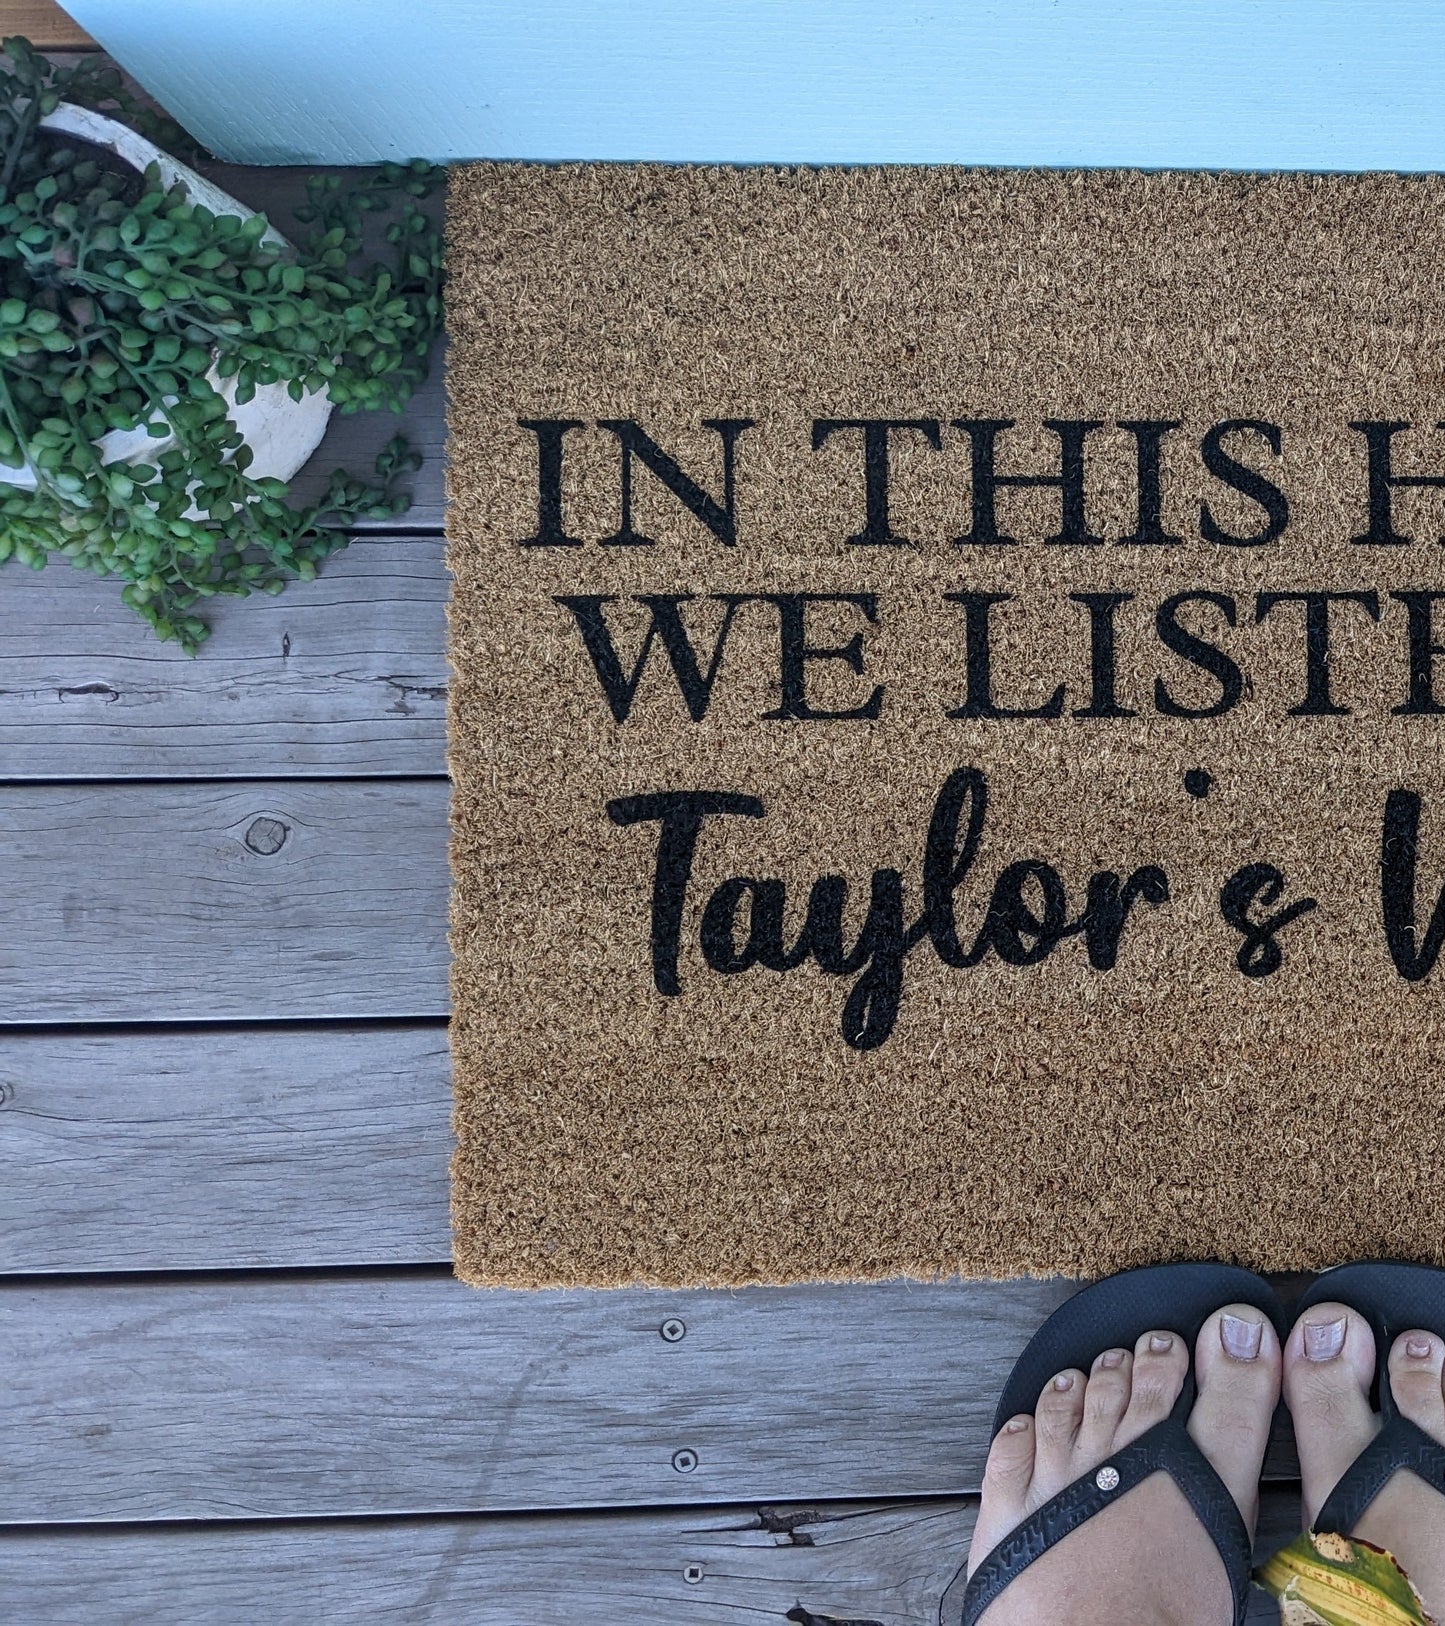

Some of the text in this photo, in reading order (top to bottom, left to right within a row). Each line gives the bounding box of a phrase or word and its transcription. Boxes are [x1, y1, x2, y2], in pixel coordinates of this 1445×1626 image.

[517, 418, 756, 549] IN
[811, 417, 1291, 549] THIS
[552, 590, 885, 725] WE
[604, 765, 1318, 1053] Taylor's
